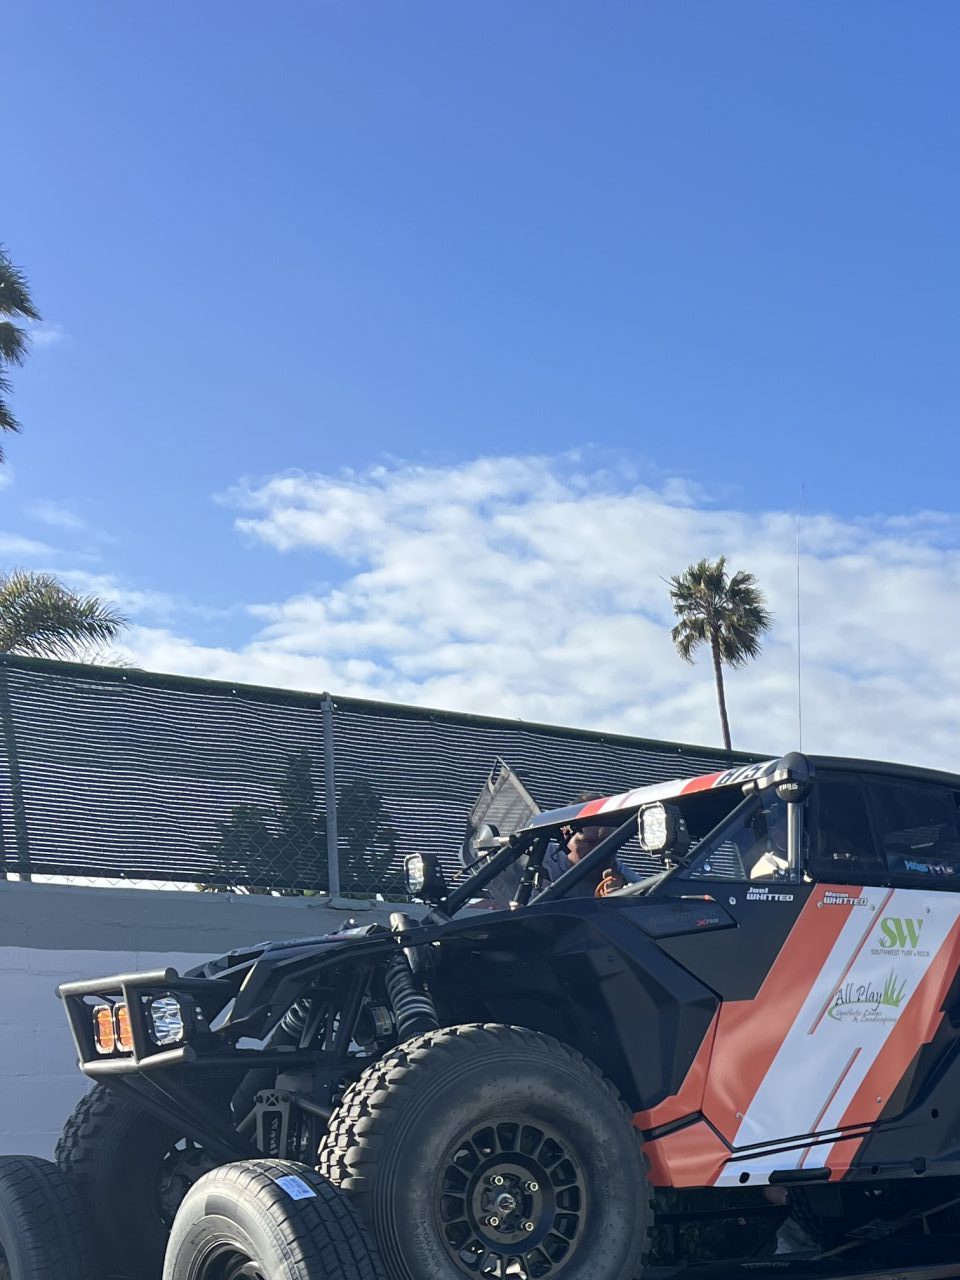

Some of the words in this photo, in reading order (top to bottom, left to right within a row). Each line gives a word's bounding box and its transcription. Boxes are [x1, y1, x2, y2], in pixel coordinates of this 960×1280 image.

[746, 893, 794, 901] WHITTED
[823, 896, 868, 906] WHITTED
[880, 917, 924, 949] SW
[834, 982, 854, 1006] All
[856, 981, 883, 1011] Play
